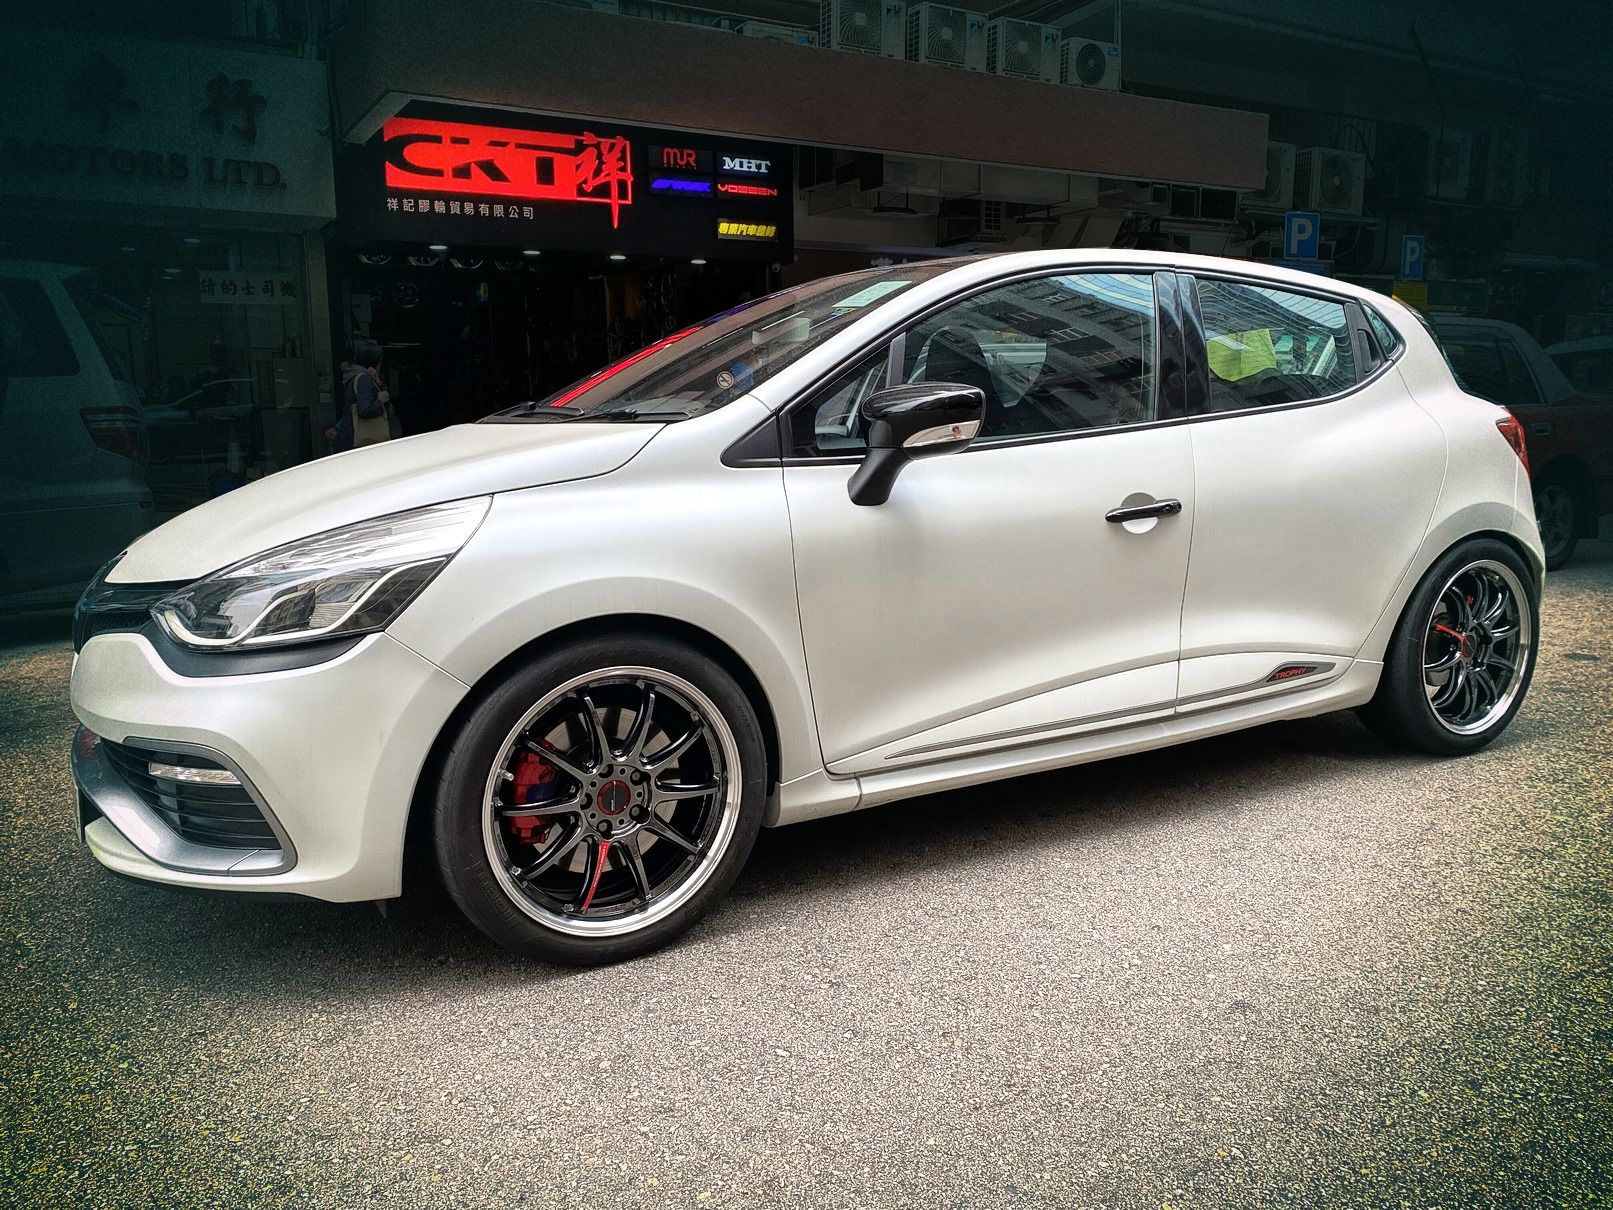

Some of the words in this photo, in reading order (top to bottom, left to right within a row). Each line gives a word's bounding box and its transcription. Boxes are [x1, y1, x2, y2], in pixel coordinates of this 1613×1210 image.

[202, 156, 288, 190] LTD.
[386, 132, 576, 187] CKT
[722, 156, 771, 173] MHT
[717, 183, 778, 197] VOSSEN
[386, 197, 535, 220] 祥記膠輪貿易有限公司
[1290, 217, 1313, 255] P
[1404, 240, 1420, 275] P
[1275, 667, 1308, 680] TROPHY
